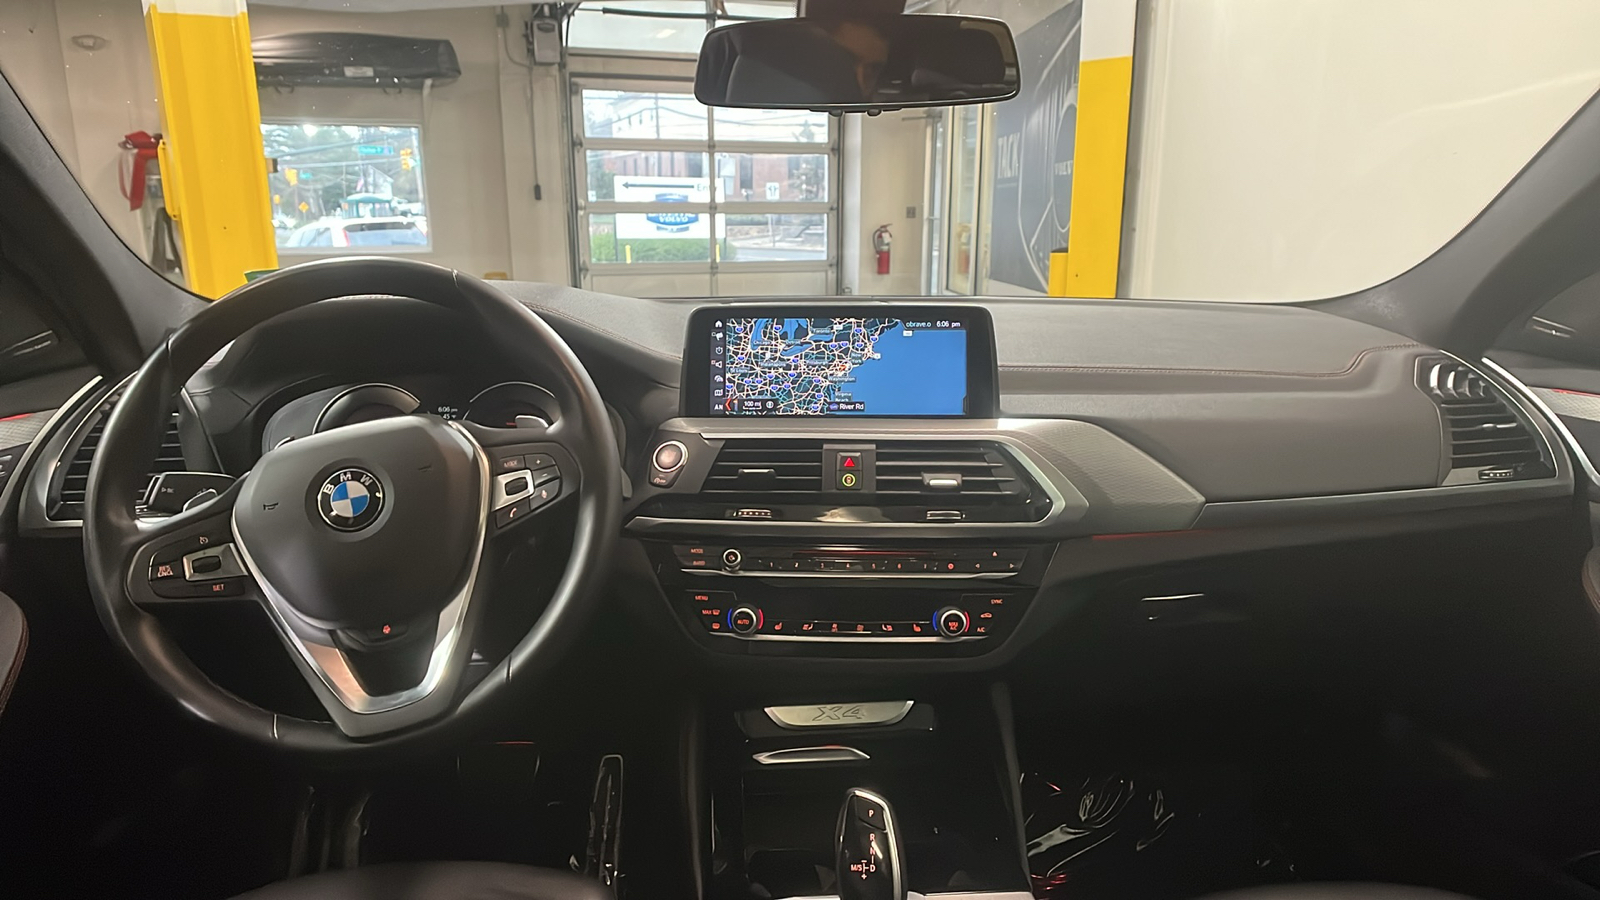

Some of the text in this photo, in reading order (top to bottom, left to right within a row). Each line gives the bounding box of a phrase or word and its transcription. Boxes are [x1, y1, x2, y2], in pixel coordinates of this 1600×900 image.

[997, 132, 1020, 179] TACK
[1054, 160, 1073, 175] VOLV
[322, 471, 374, 495] BMW
[812, 704, 865, 721] X4
[868, 809, 875, 818] P
[869, 833, 875, 841] R
[869, 847, 876, 855] N
[869, 864, 876, 872] D
